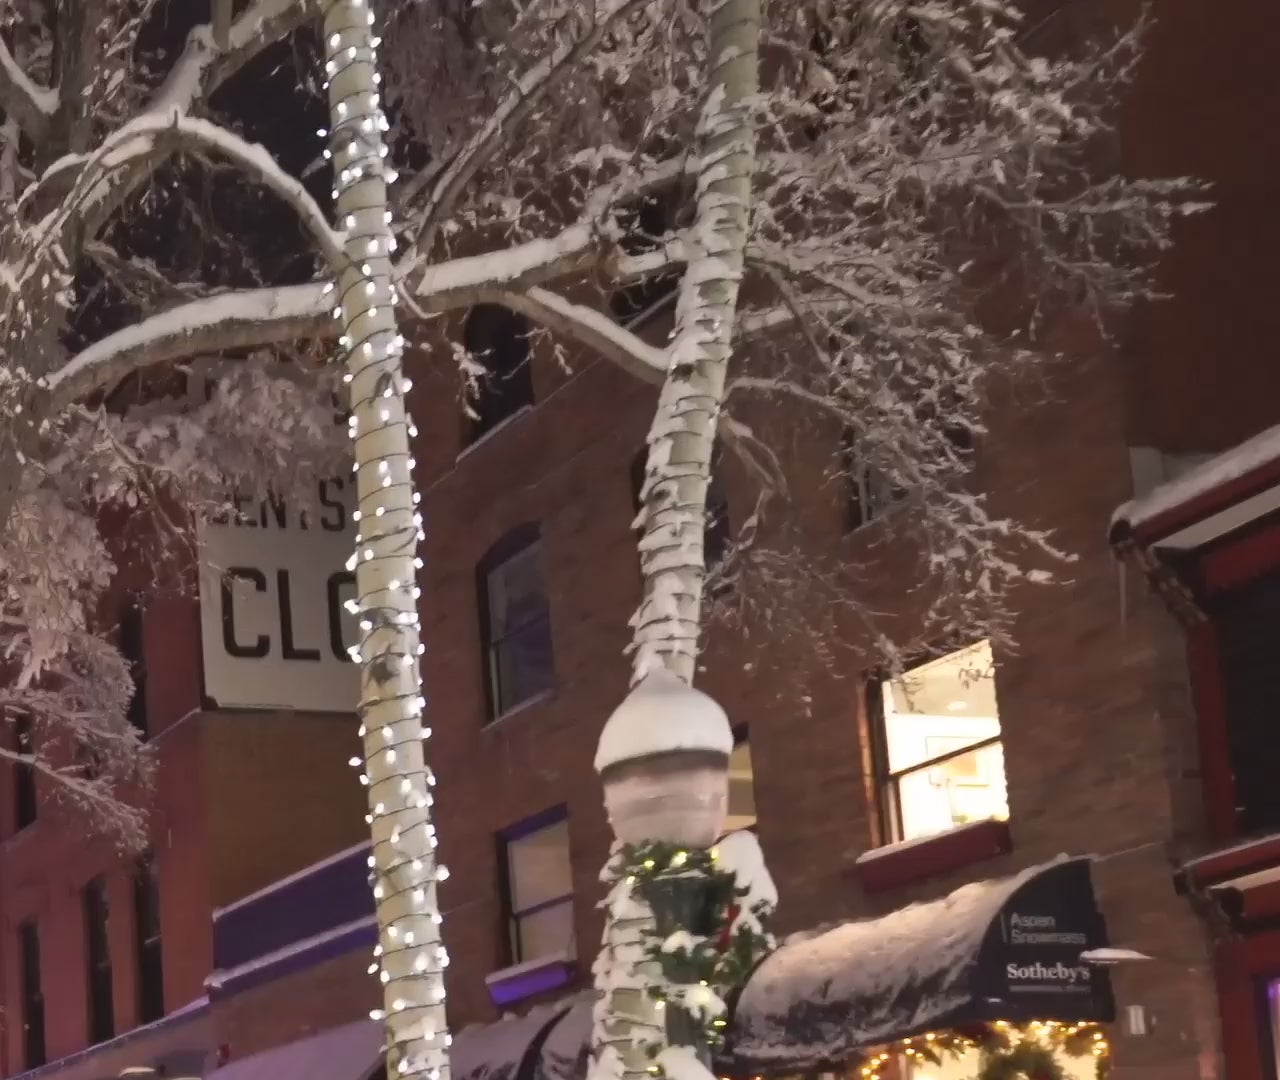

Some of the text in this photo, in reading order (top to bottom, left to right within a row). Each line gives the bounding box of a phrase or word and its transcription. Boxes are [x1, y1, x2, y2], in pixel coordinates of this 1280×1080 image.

[1011, 912, 1056, 928] Aspen
[1011, 929, 1088, 945] Snowmass
[1006, 961, 1091, 983] Sotheby's
